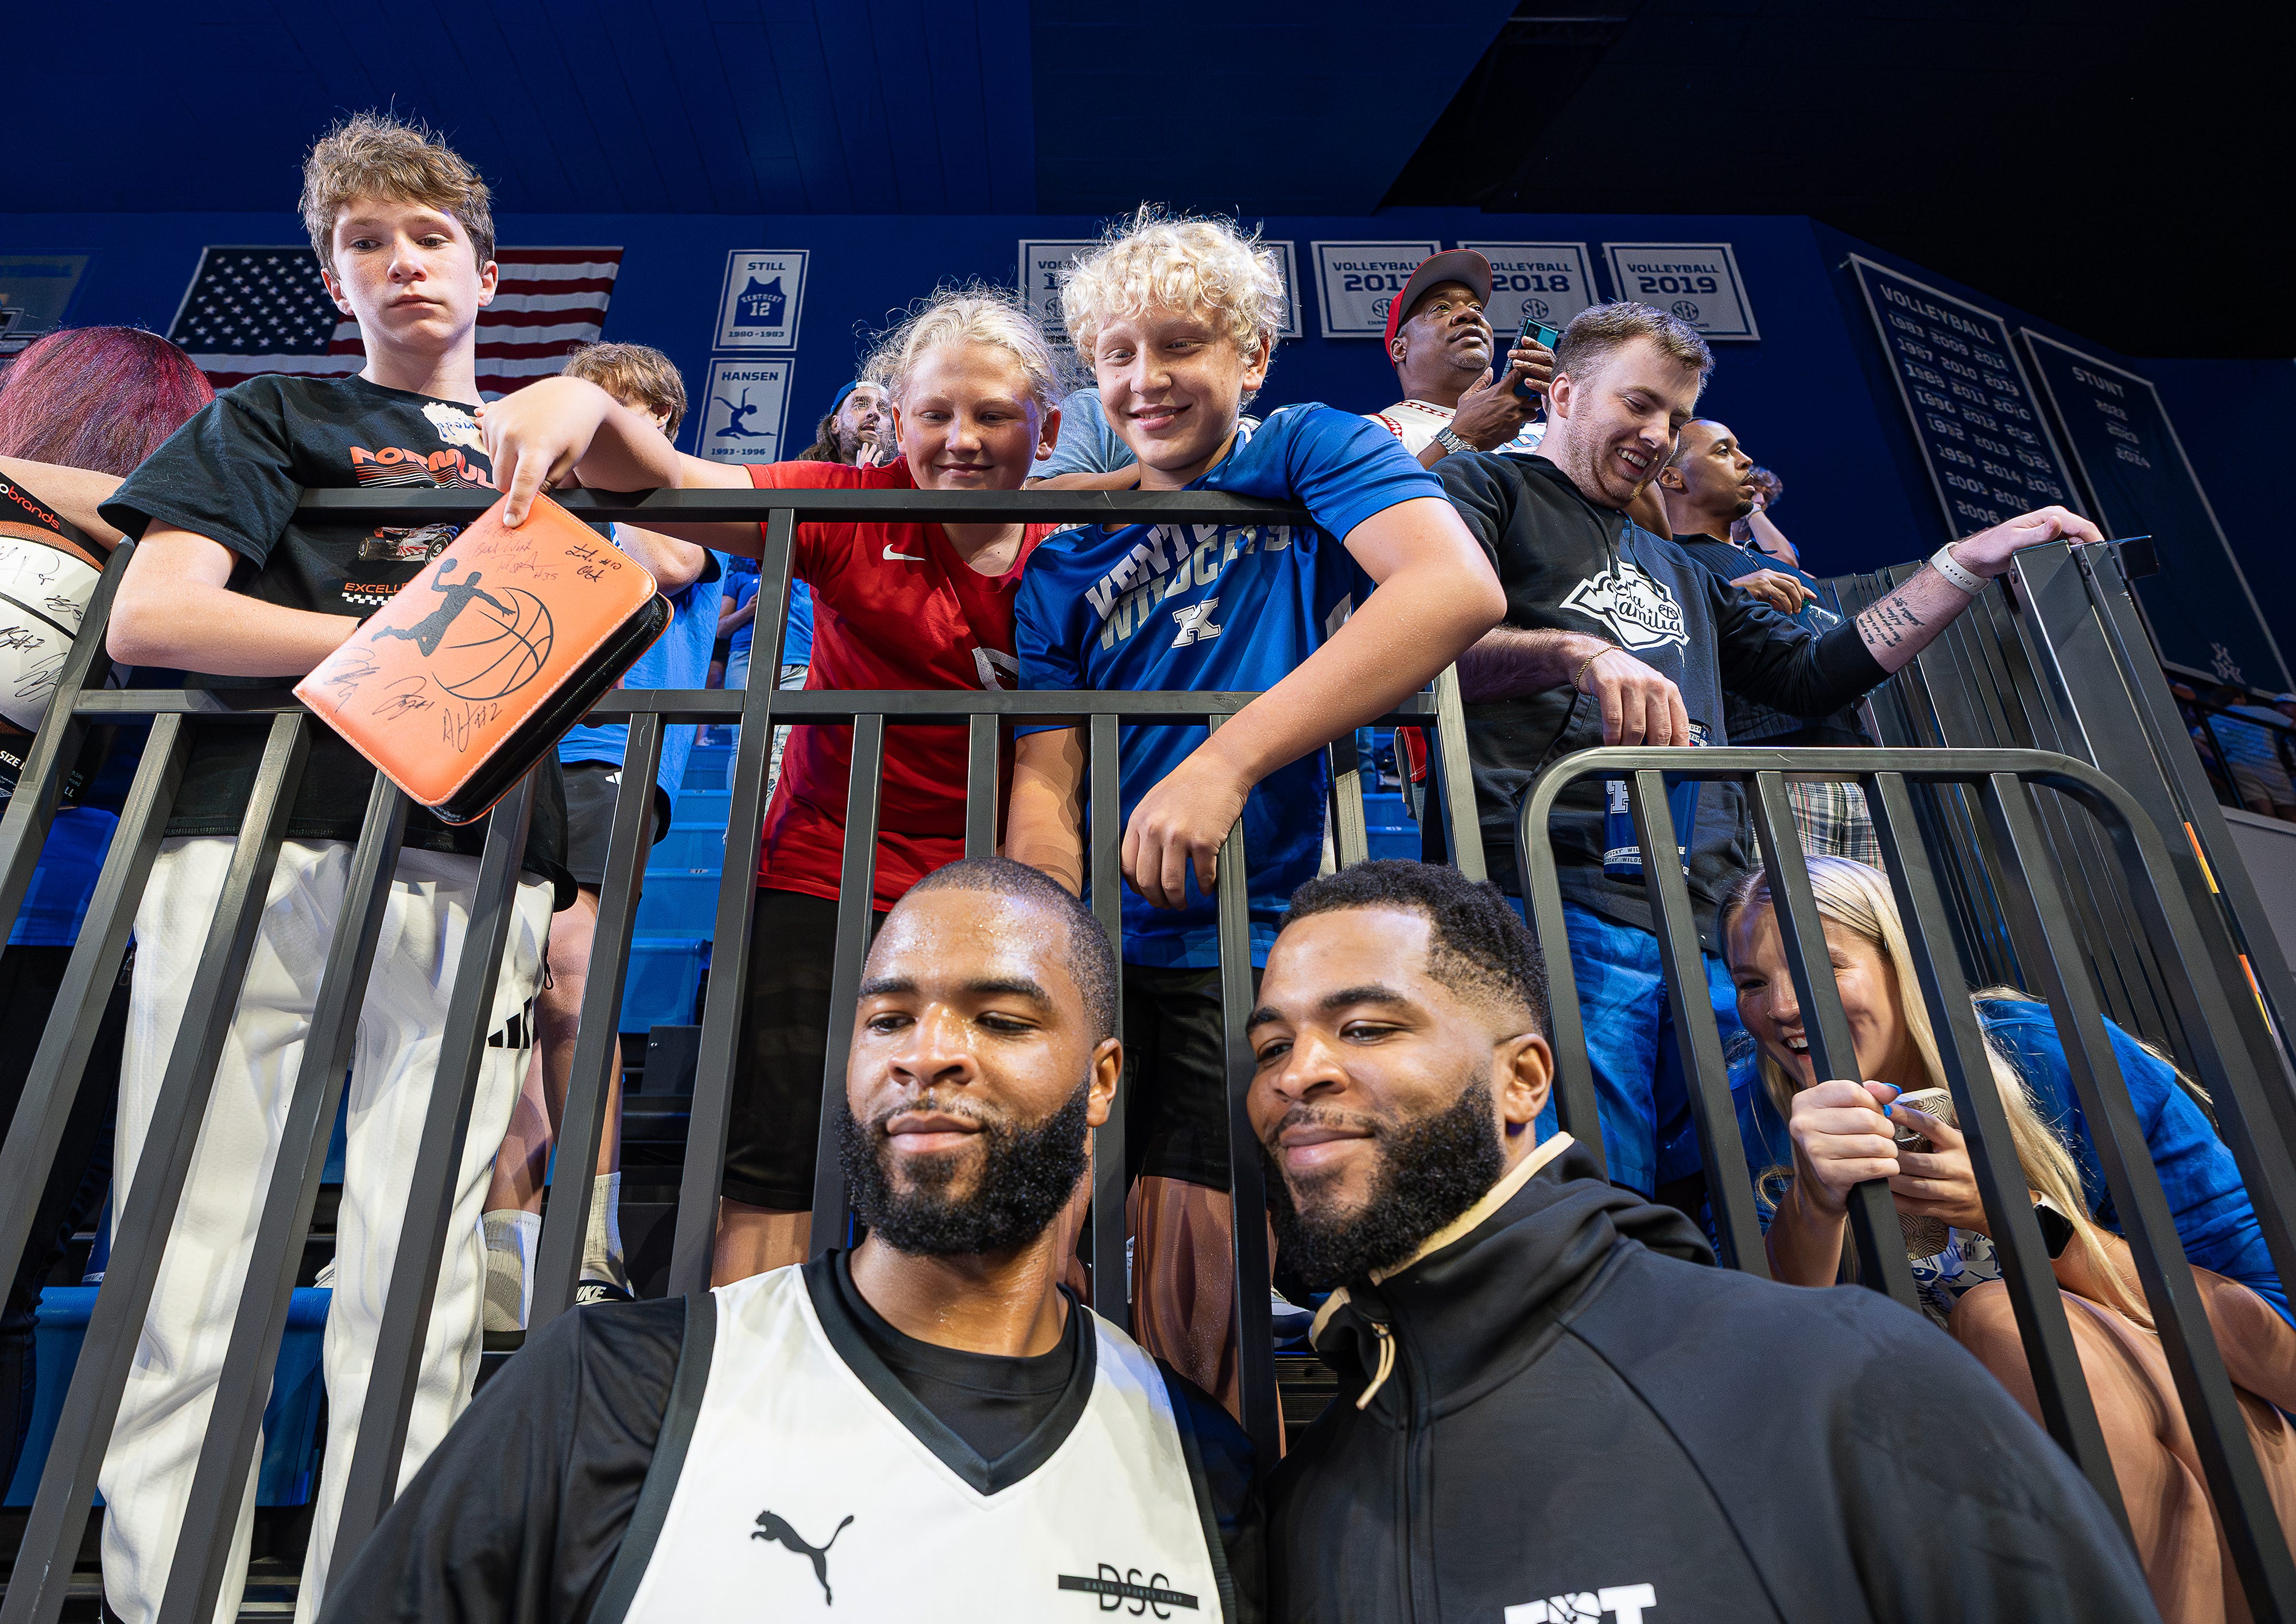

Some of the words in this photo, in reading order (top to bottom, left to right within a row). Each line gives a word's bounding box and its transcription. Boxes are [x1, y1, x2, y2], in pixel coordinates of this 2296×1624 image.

[747, 262, 786, 270] STILL
[1491, 262, 1573, 272] OLLEYBALL
[1627, 263, 1720, 273] VOLLEYBALL
[1344, 274, 1413, 292] 2017
[1492, 274, 1570, 292] 2018
[1638, 276, 1717, 293] 2019
[750, 302, 770, 316] 12
[1880, 284, 1995, 344] VOLLEYBALL
[722, 372, 779, 381] HANSEN
[2072, 367, 2124, 397] STUNT
[350, 446, 501, 489] FORMUL
[344, 583, 408, 595] EXCELL
[0, 750, 19, 767] SIZE
[575, 1285, 607, 1302] IKE
